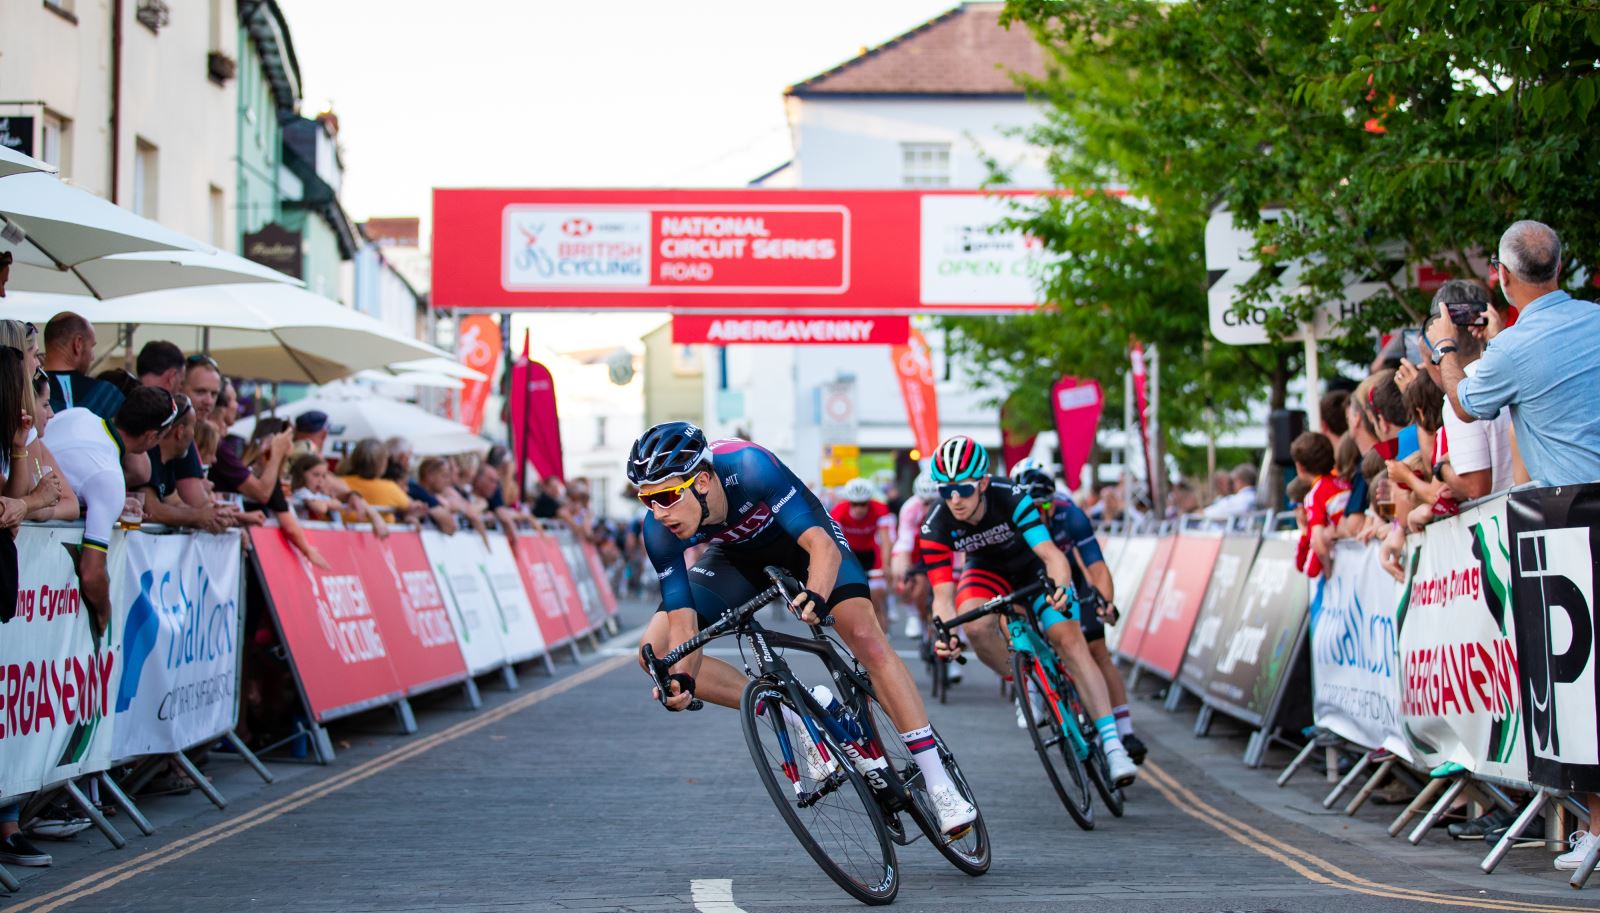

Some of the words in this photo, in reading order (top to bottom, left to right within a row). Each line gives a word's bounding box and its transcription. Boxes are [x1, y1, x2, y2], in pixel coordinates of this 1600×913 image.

[661, 216, 770, 237] NATIONAL
[558, 242, 642, 258] BRITISH
[660, 238, 746, 259] CIRCUIT
[751, 238, 836, 260] SERIES
[558, 259, 642, 276] CYCLING
[660, 262, 713, 281] ROAD
[937, 259, 1002, 277] OPEN
[707, 320, 874, 341] ABERGAVENNY
[954, 522, 1010, 550] MADISON
